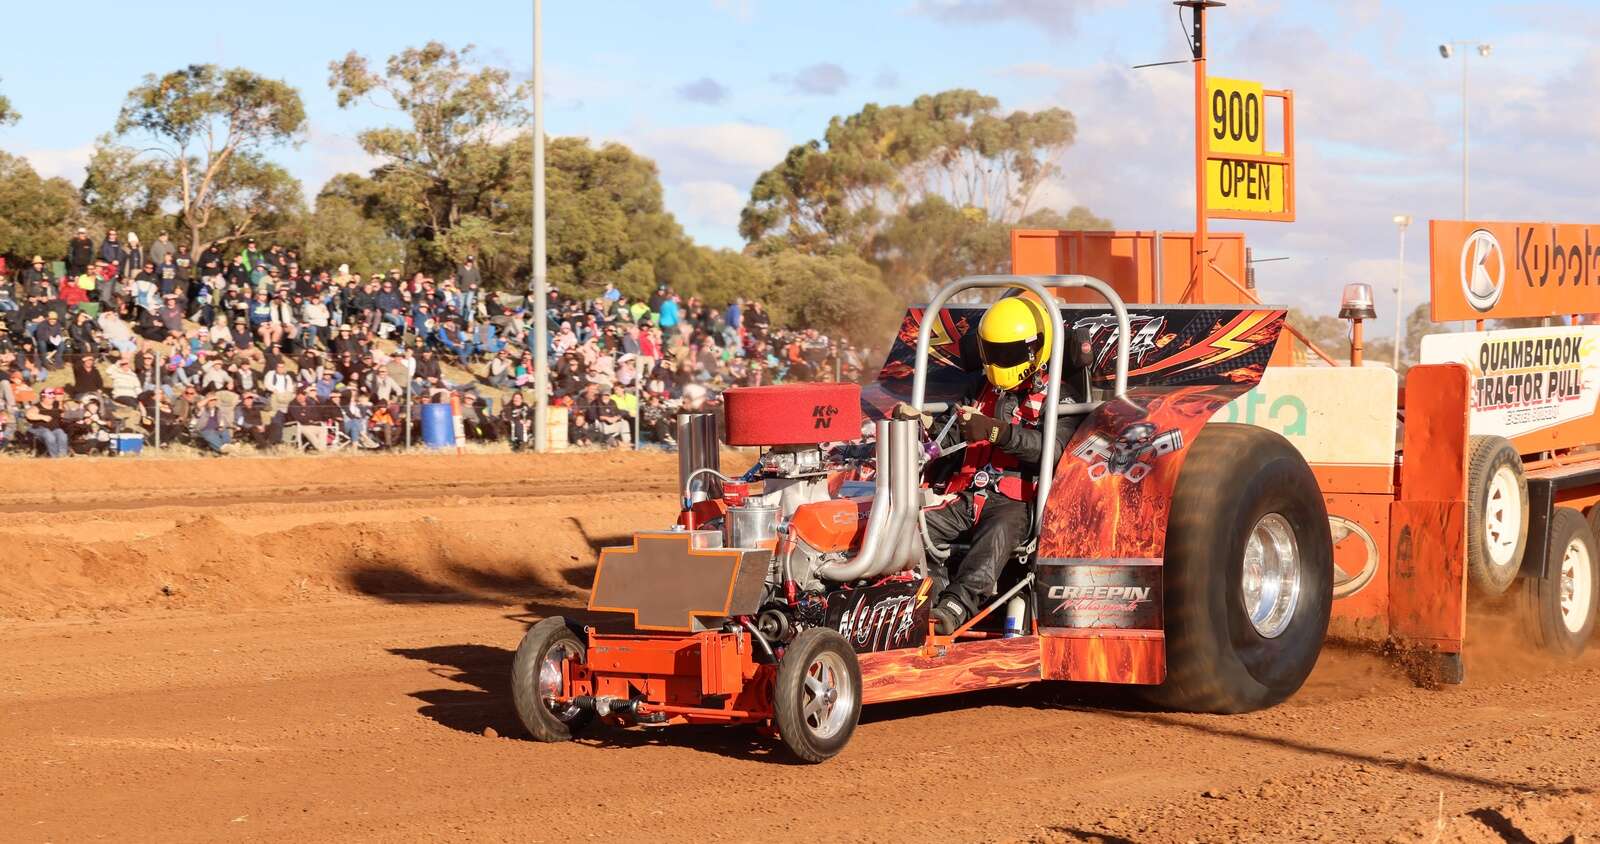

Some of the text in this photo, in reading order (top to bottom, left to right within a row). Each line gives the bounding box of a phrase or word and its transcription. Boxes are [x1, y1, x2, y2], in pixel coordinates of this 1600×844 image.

[1212, 88, 1259, 143] 900
[1220, 159, 1270, 201] OPEN
[1480, 336, 1583, 377] QUAMBATOOK
[1476, 368, 1581, 407] TRACTOR PULL
[1047, 585, 1152, 601] CREEPIN
[839, 593, 917, 652] NUTTA
